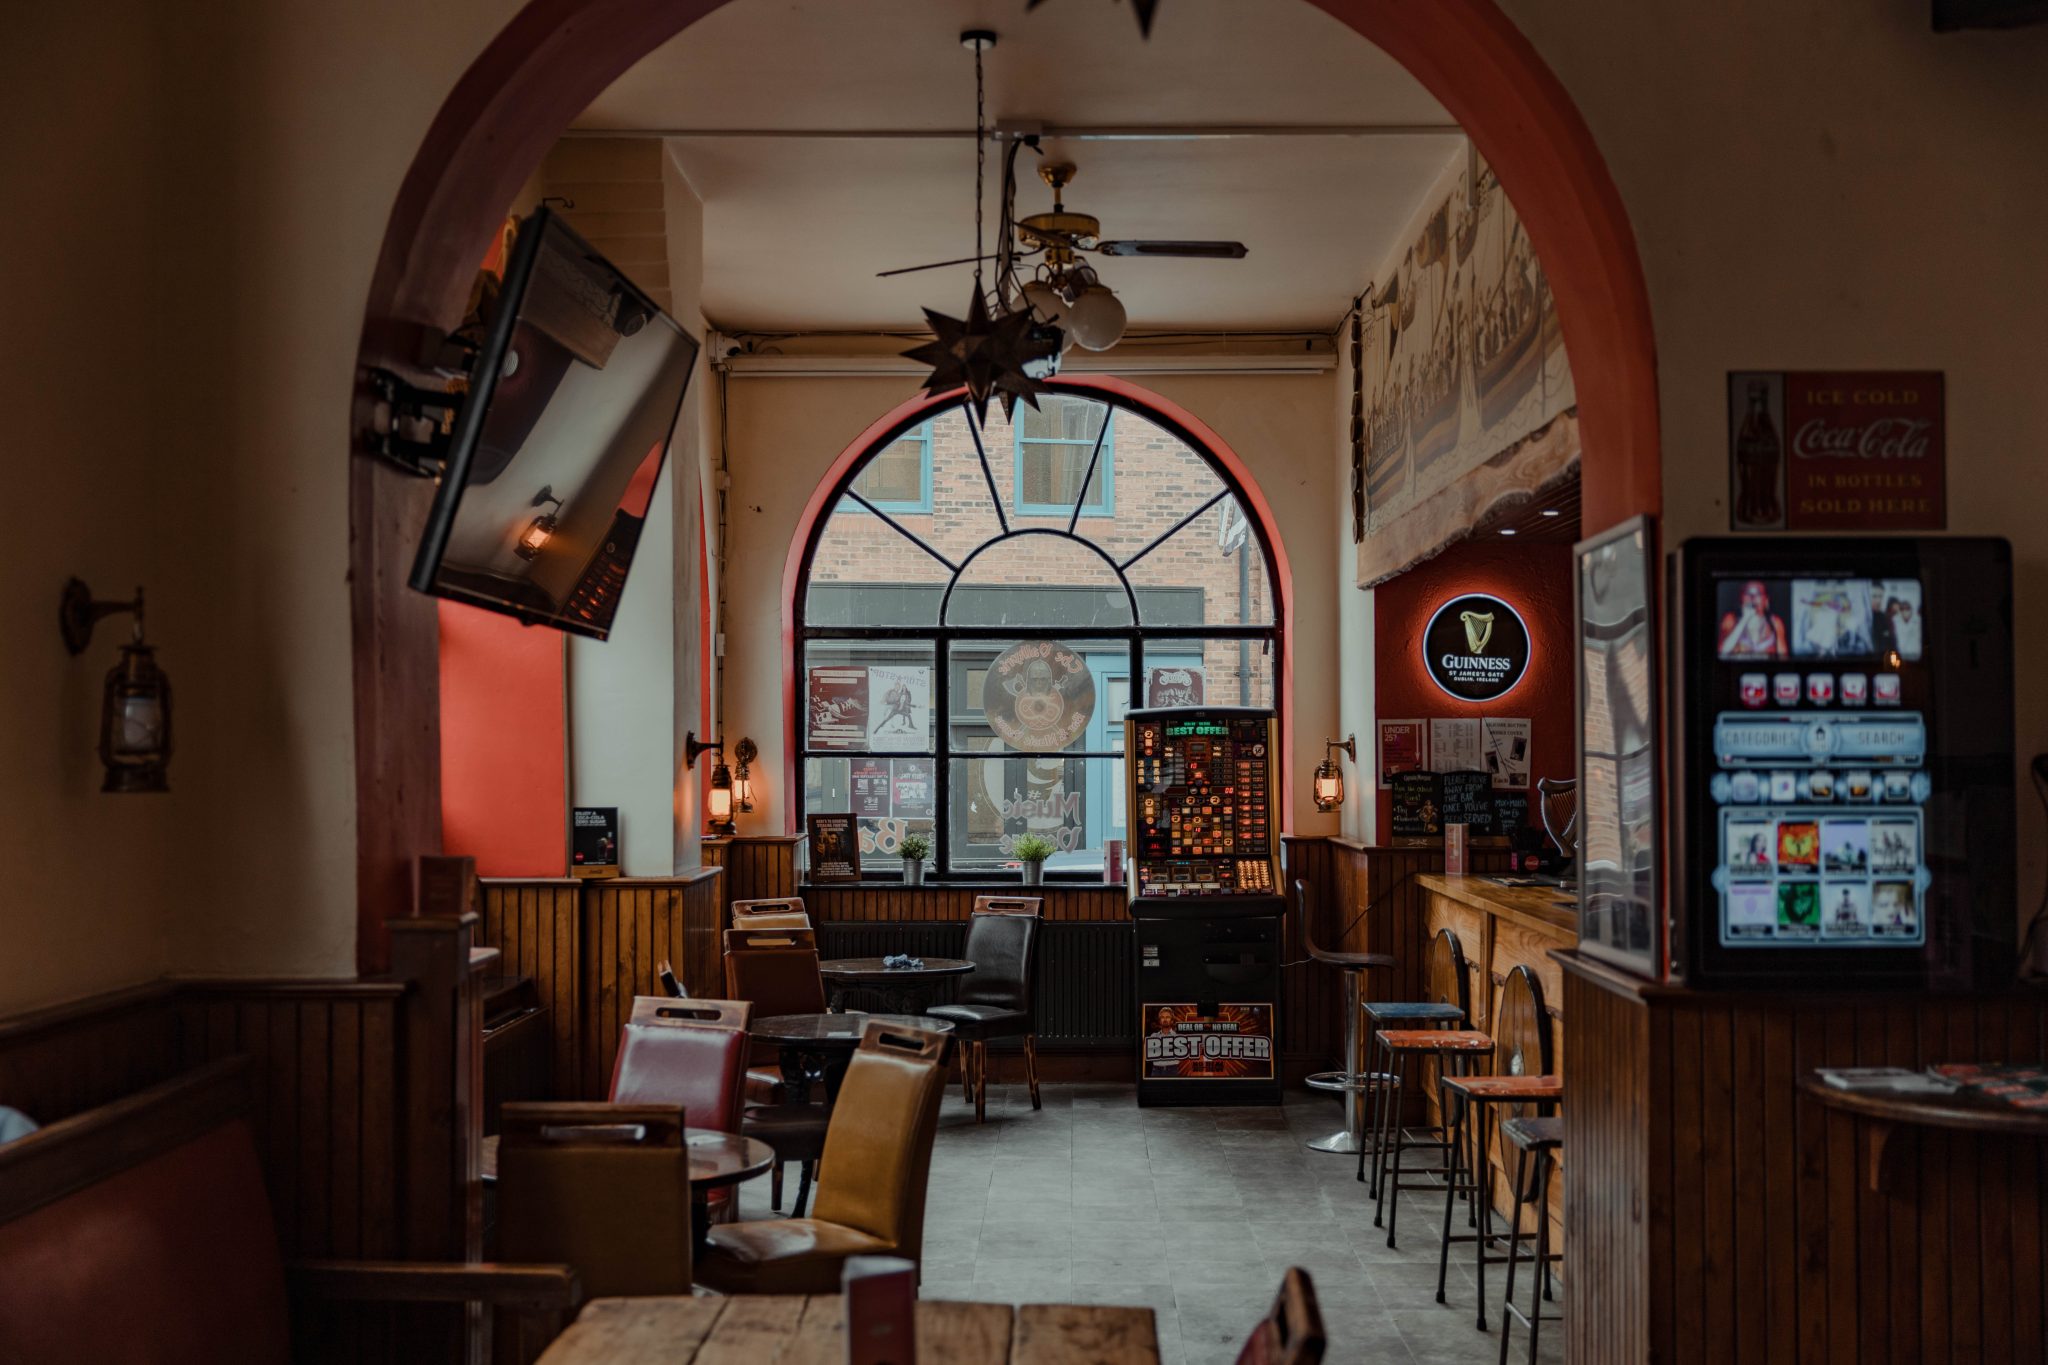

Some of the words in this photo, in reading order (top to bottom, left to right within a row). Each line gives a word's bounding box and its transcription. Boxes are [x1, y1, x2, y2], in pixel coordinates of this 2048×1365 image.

[1807, 390, 1842, 405] ICE
[1853, 389, 1920, 405] COLD
[1792, 417, 1935, 460] Coca-Cola
[1807, 474, 1827, 488] IN
[1835, 474, 1922, 488] BOTTLES
[1800, 499, 1862, 514] SOLD
[1868, 499, 1931, 514] HERE
[1442, 654, 1511, 670] GUINNESS
[1166, 727, 1195, 736] BEST
[1196, 727, 1230, 735] OFFER
[1384, 726, 1410, 735] UNDER
[1723, 732, 1796, 746] CATEGORIES
[1857, 731, 1906, 745] SEARCH
[1444, 784, 1464, 796] AWAY
[1465, 783, 1484, 793] FROM
[1461, 791, 1474, 803] BAR
[1177, 1023, 1193, 1032] DEAL
[1194, 1023, 1204, 1032] OR
[1212, 1023, 1222, 1032] NO
[1222, 1023, 1238, 1032] DEAL
[1146, 1035, 1203, 1059] BEST
[1204, 1035, 1271, 1060] OFFER
